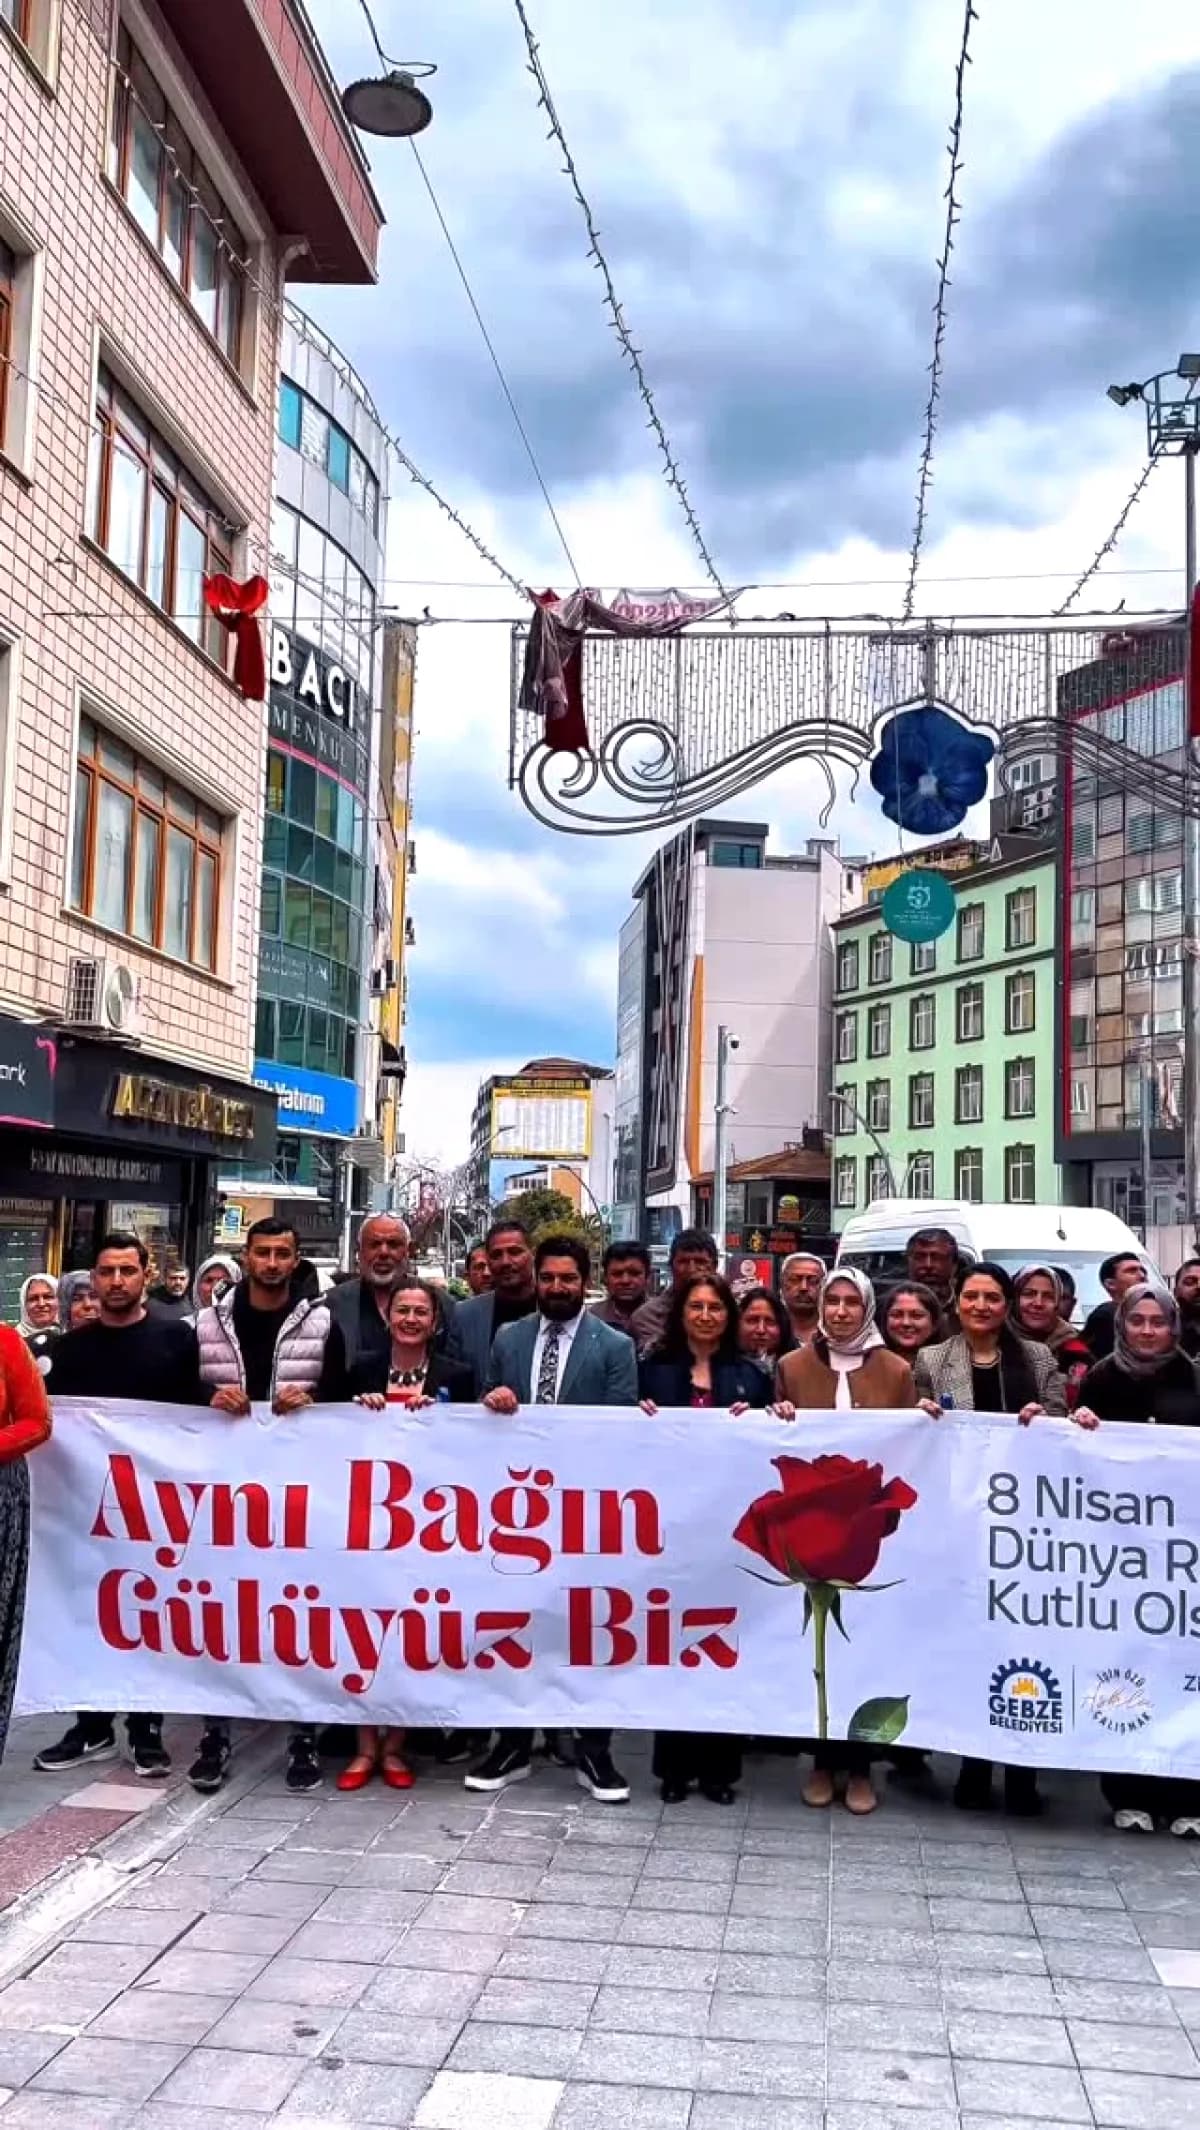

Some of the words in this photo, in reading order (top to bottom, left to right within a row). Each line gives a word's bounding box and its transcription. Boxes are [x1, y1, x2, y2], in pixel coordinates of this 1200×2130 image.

[273, 704, 348, 768] MENKUL
[90, 1454, 313, 1567] Aynı
[341, 1459, 665, 1575] Bağın
[988, 1472, 1019, 1515] 8
[1036, 1475, 1174, 1526] Nisan
[989, 1526, 1148, 1588] Dünya
[98, 1568, 533, 1693] Gülüyüz
[560, 1585, 739, 1669] Biz
[988, 1579, 1118, 1631] Kutlu
[989, 1695, 1063, 1720] GEBZE
